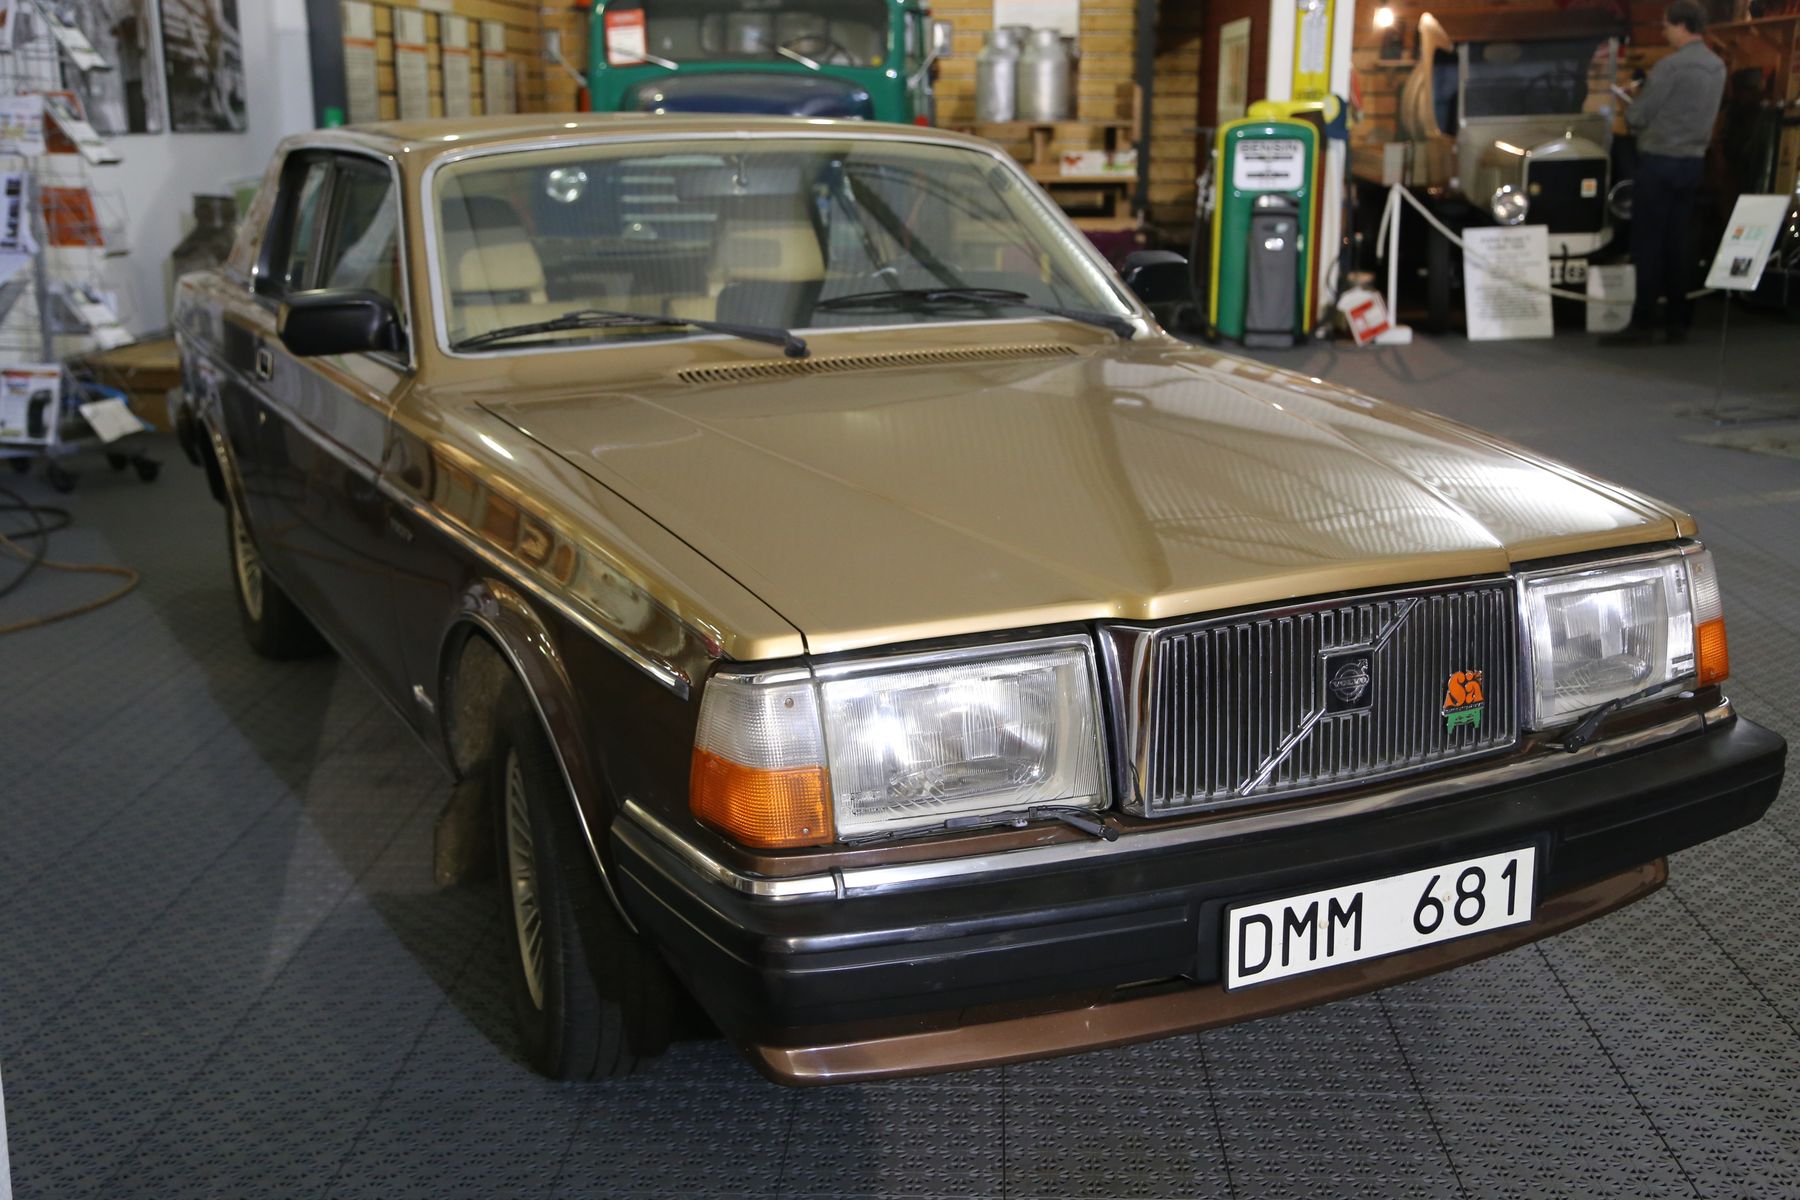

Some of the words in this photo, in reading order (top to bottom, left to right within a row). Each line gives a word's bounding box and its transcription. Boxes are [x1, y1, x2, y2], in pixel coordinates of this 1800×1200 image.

[1331, 676, 1367, 688] VOLVO
[1238, 892, 1363, 977] DMM
[1413, 859, 1517, 934] 681
